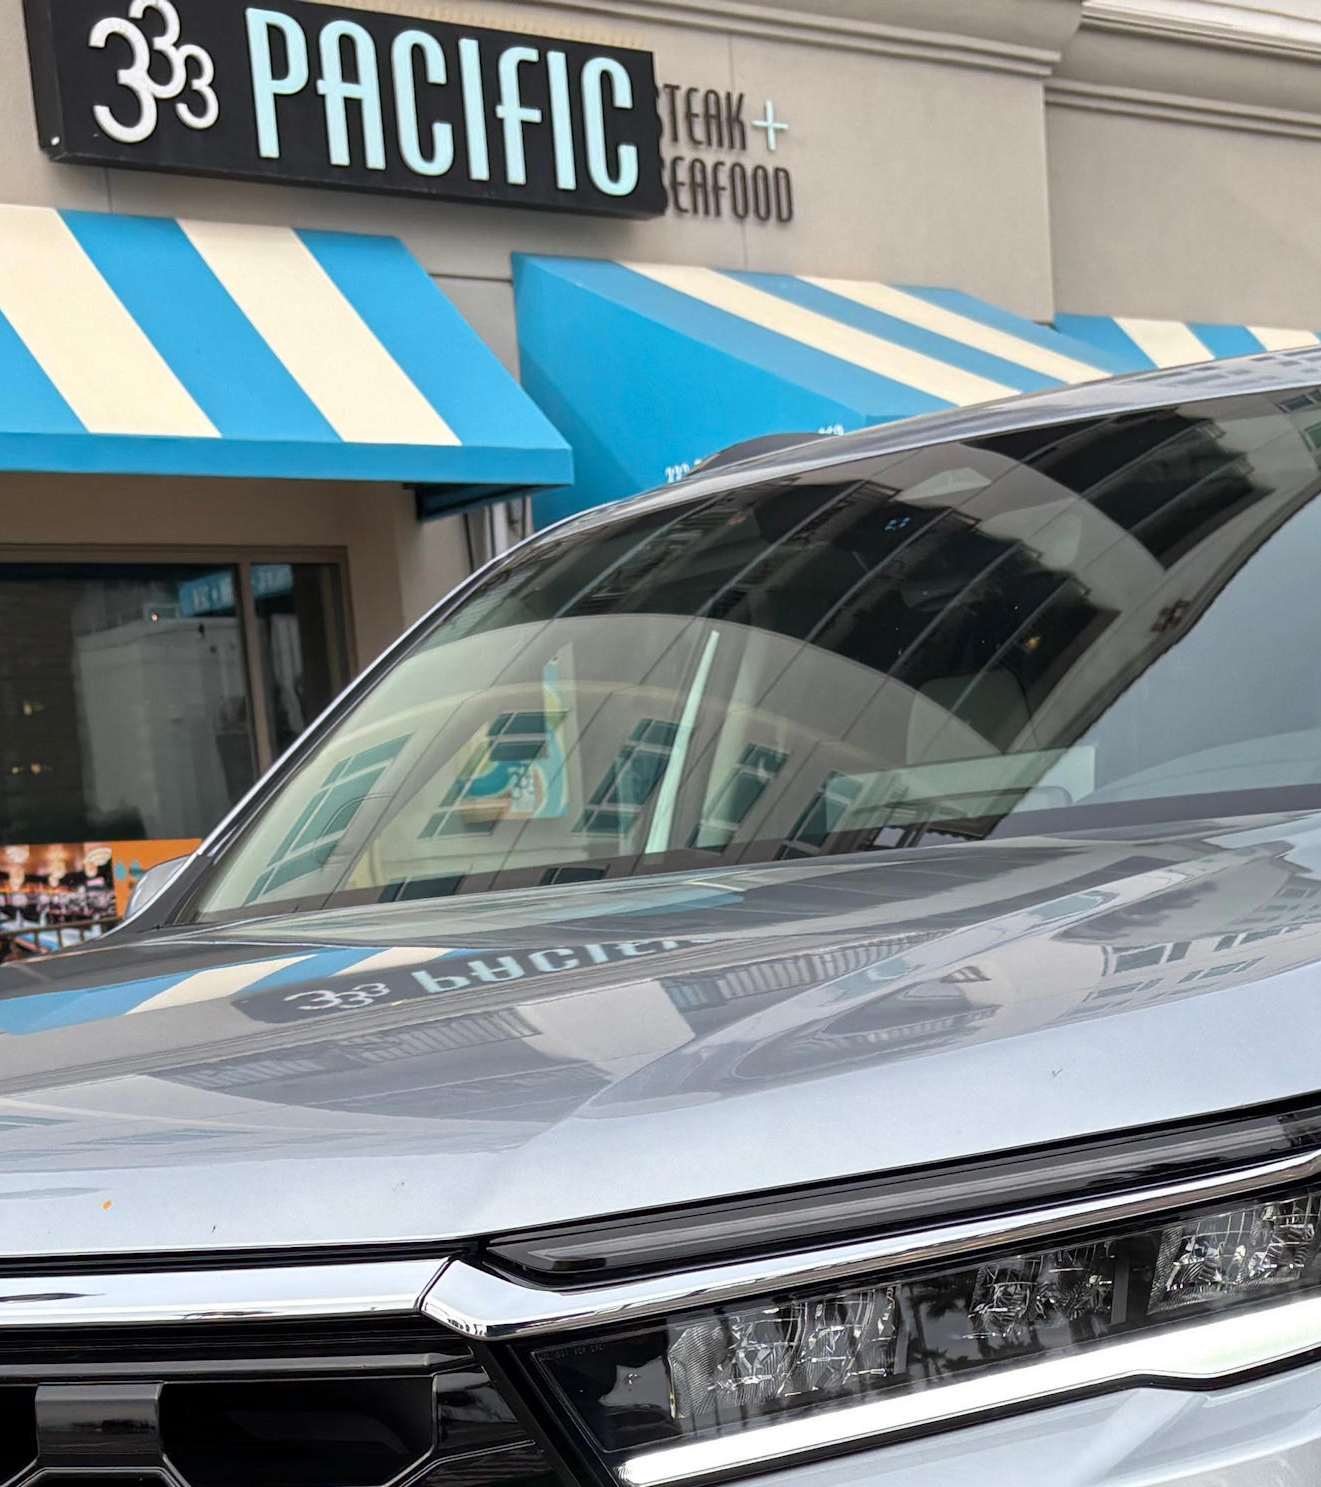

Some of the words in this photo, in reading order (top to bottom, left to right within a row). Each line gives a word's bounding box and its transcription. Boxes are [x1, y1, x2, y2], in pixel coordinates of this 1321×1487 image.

[88, 0, 219, 143] 333
[244, 7, 639, 197] PACIFIC
[662, 83, 747, 151] TEAK
[670, 156, 793, 224] EAFOOD
